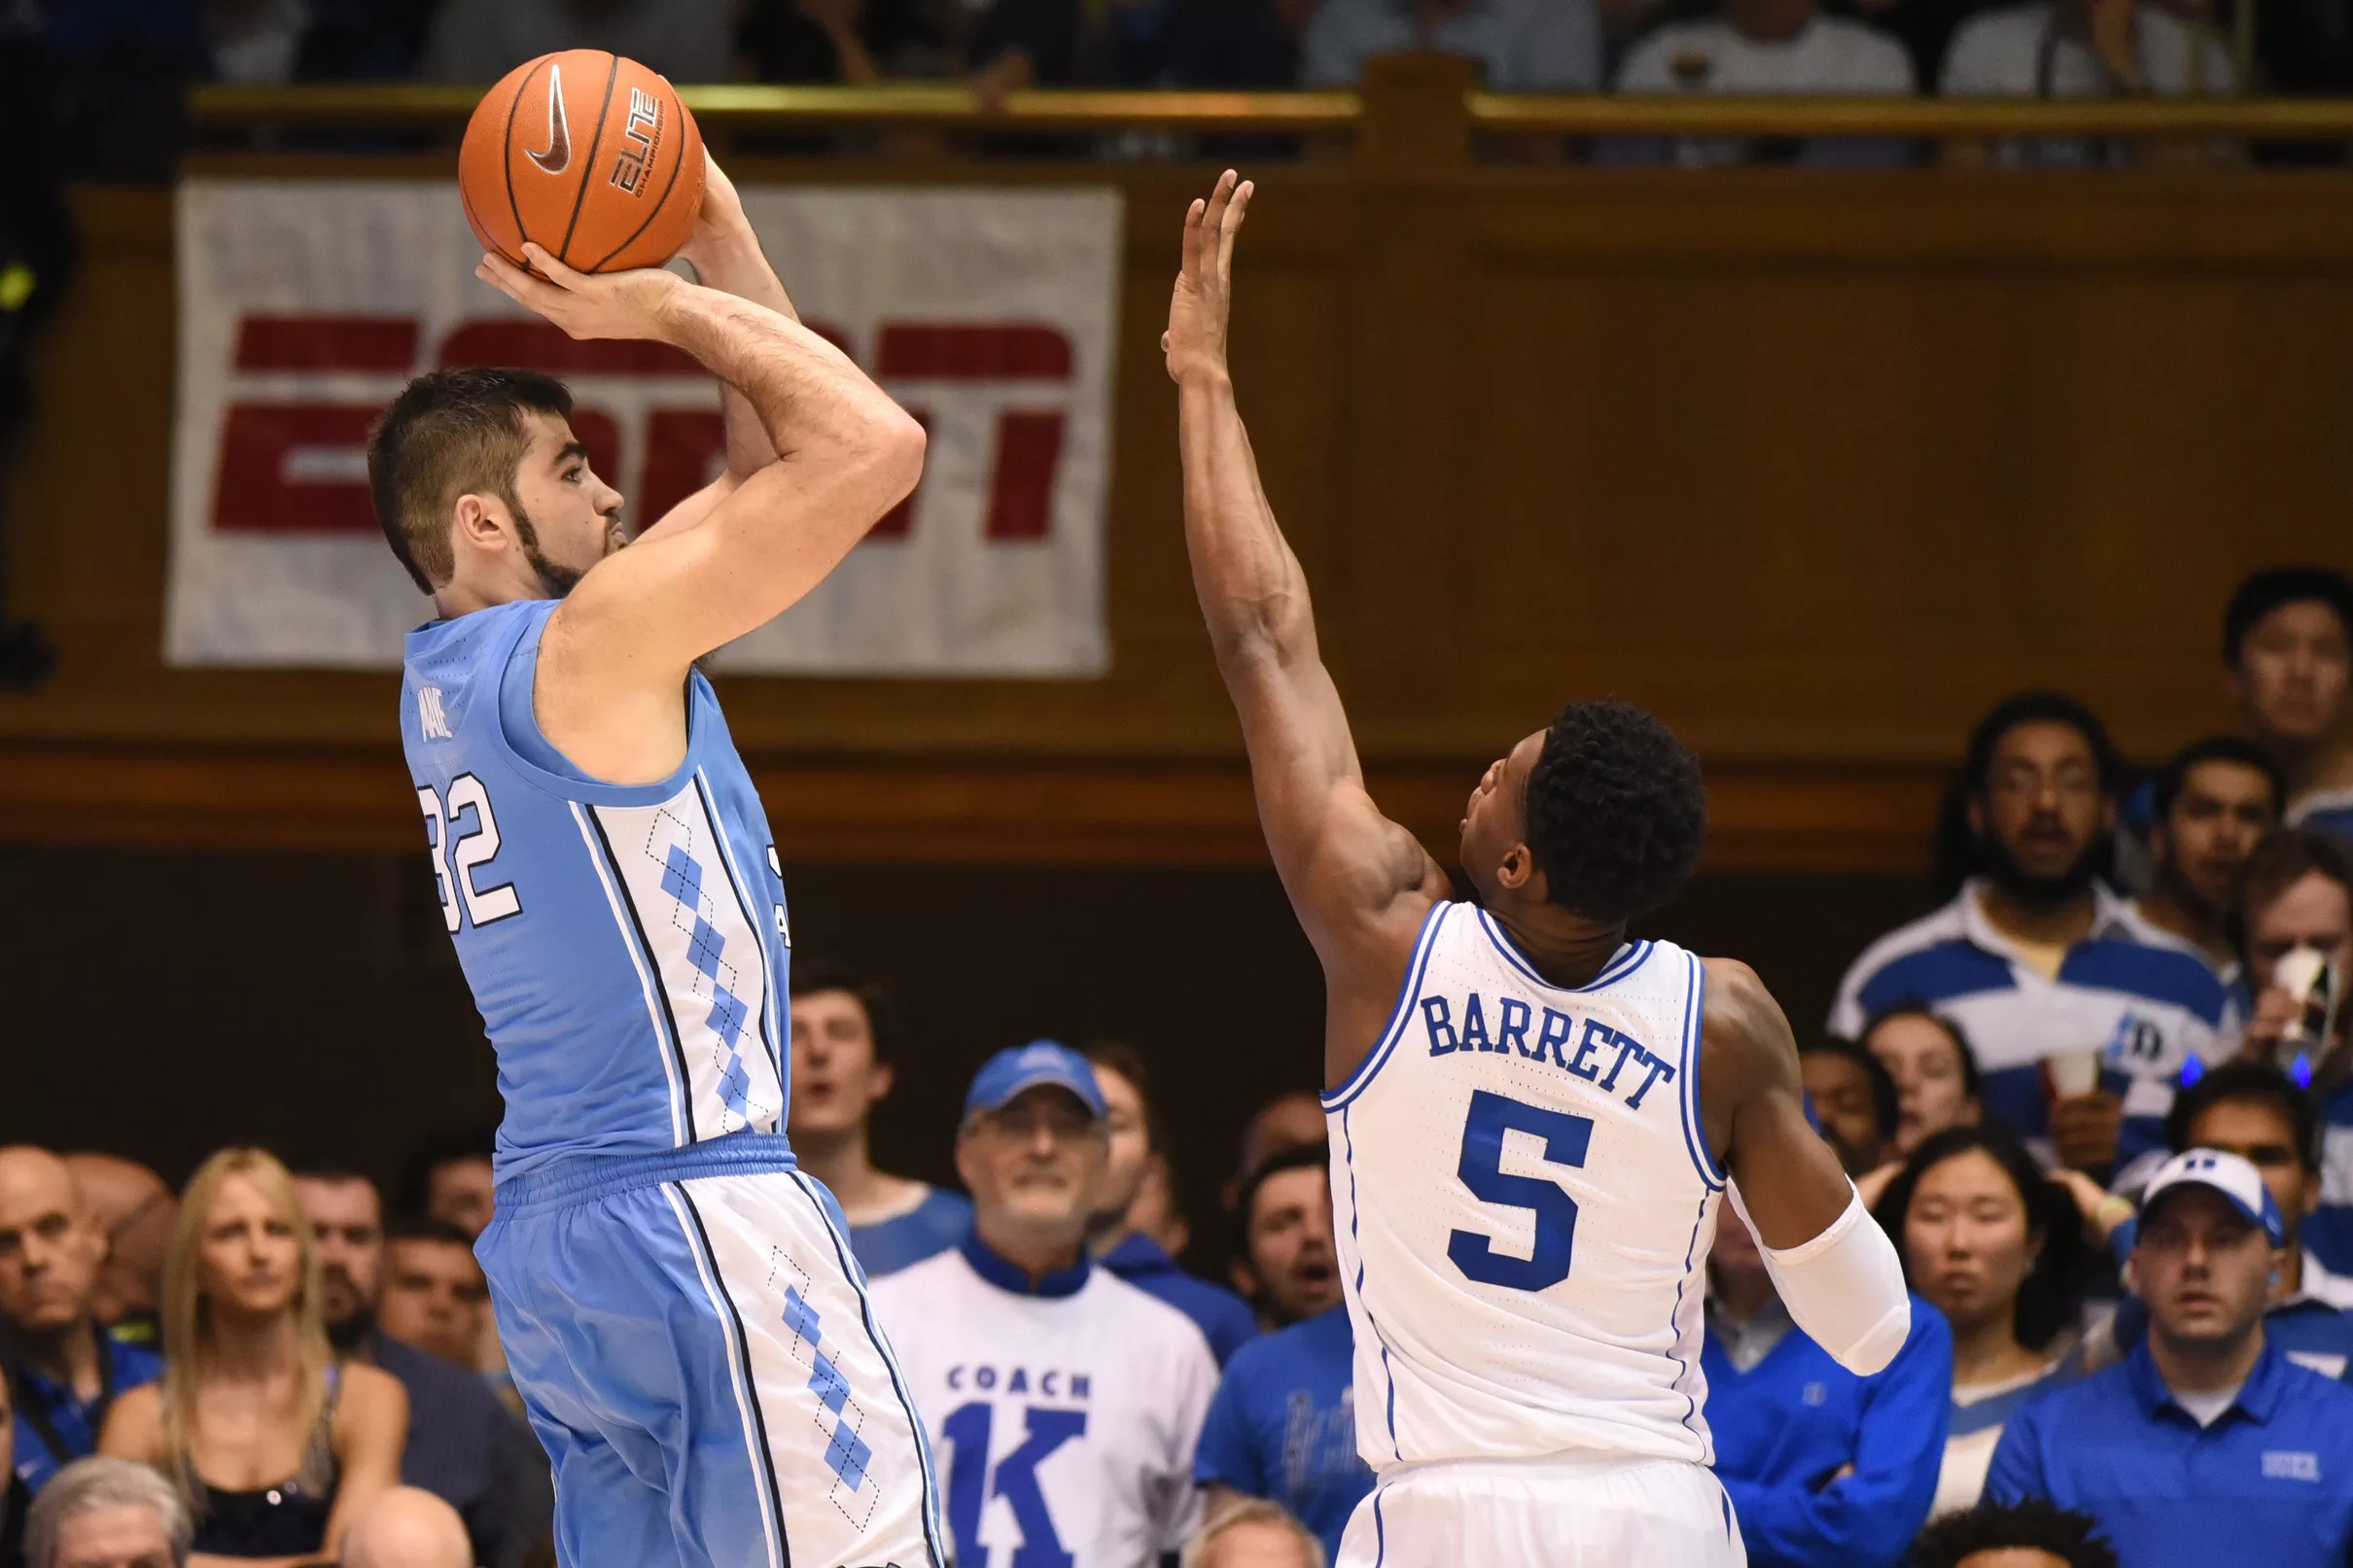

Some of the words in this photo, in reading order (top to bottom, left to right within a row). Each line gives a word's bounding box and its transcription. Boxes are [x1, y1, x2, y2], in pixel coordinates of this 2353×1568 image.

[609, 87, 658, 193] ELITE
[211, 316, 1076, 544] EN
[417, 771, 523, 935] 32
[1421, 993, 1676, 1110] BARRETT
[1447, 1089, 1594, 1292] 5
[946, 1366, 1091, 1399] COACH
